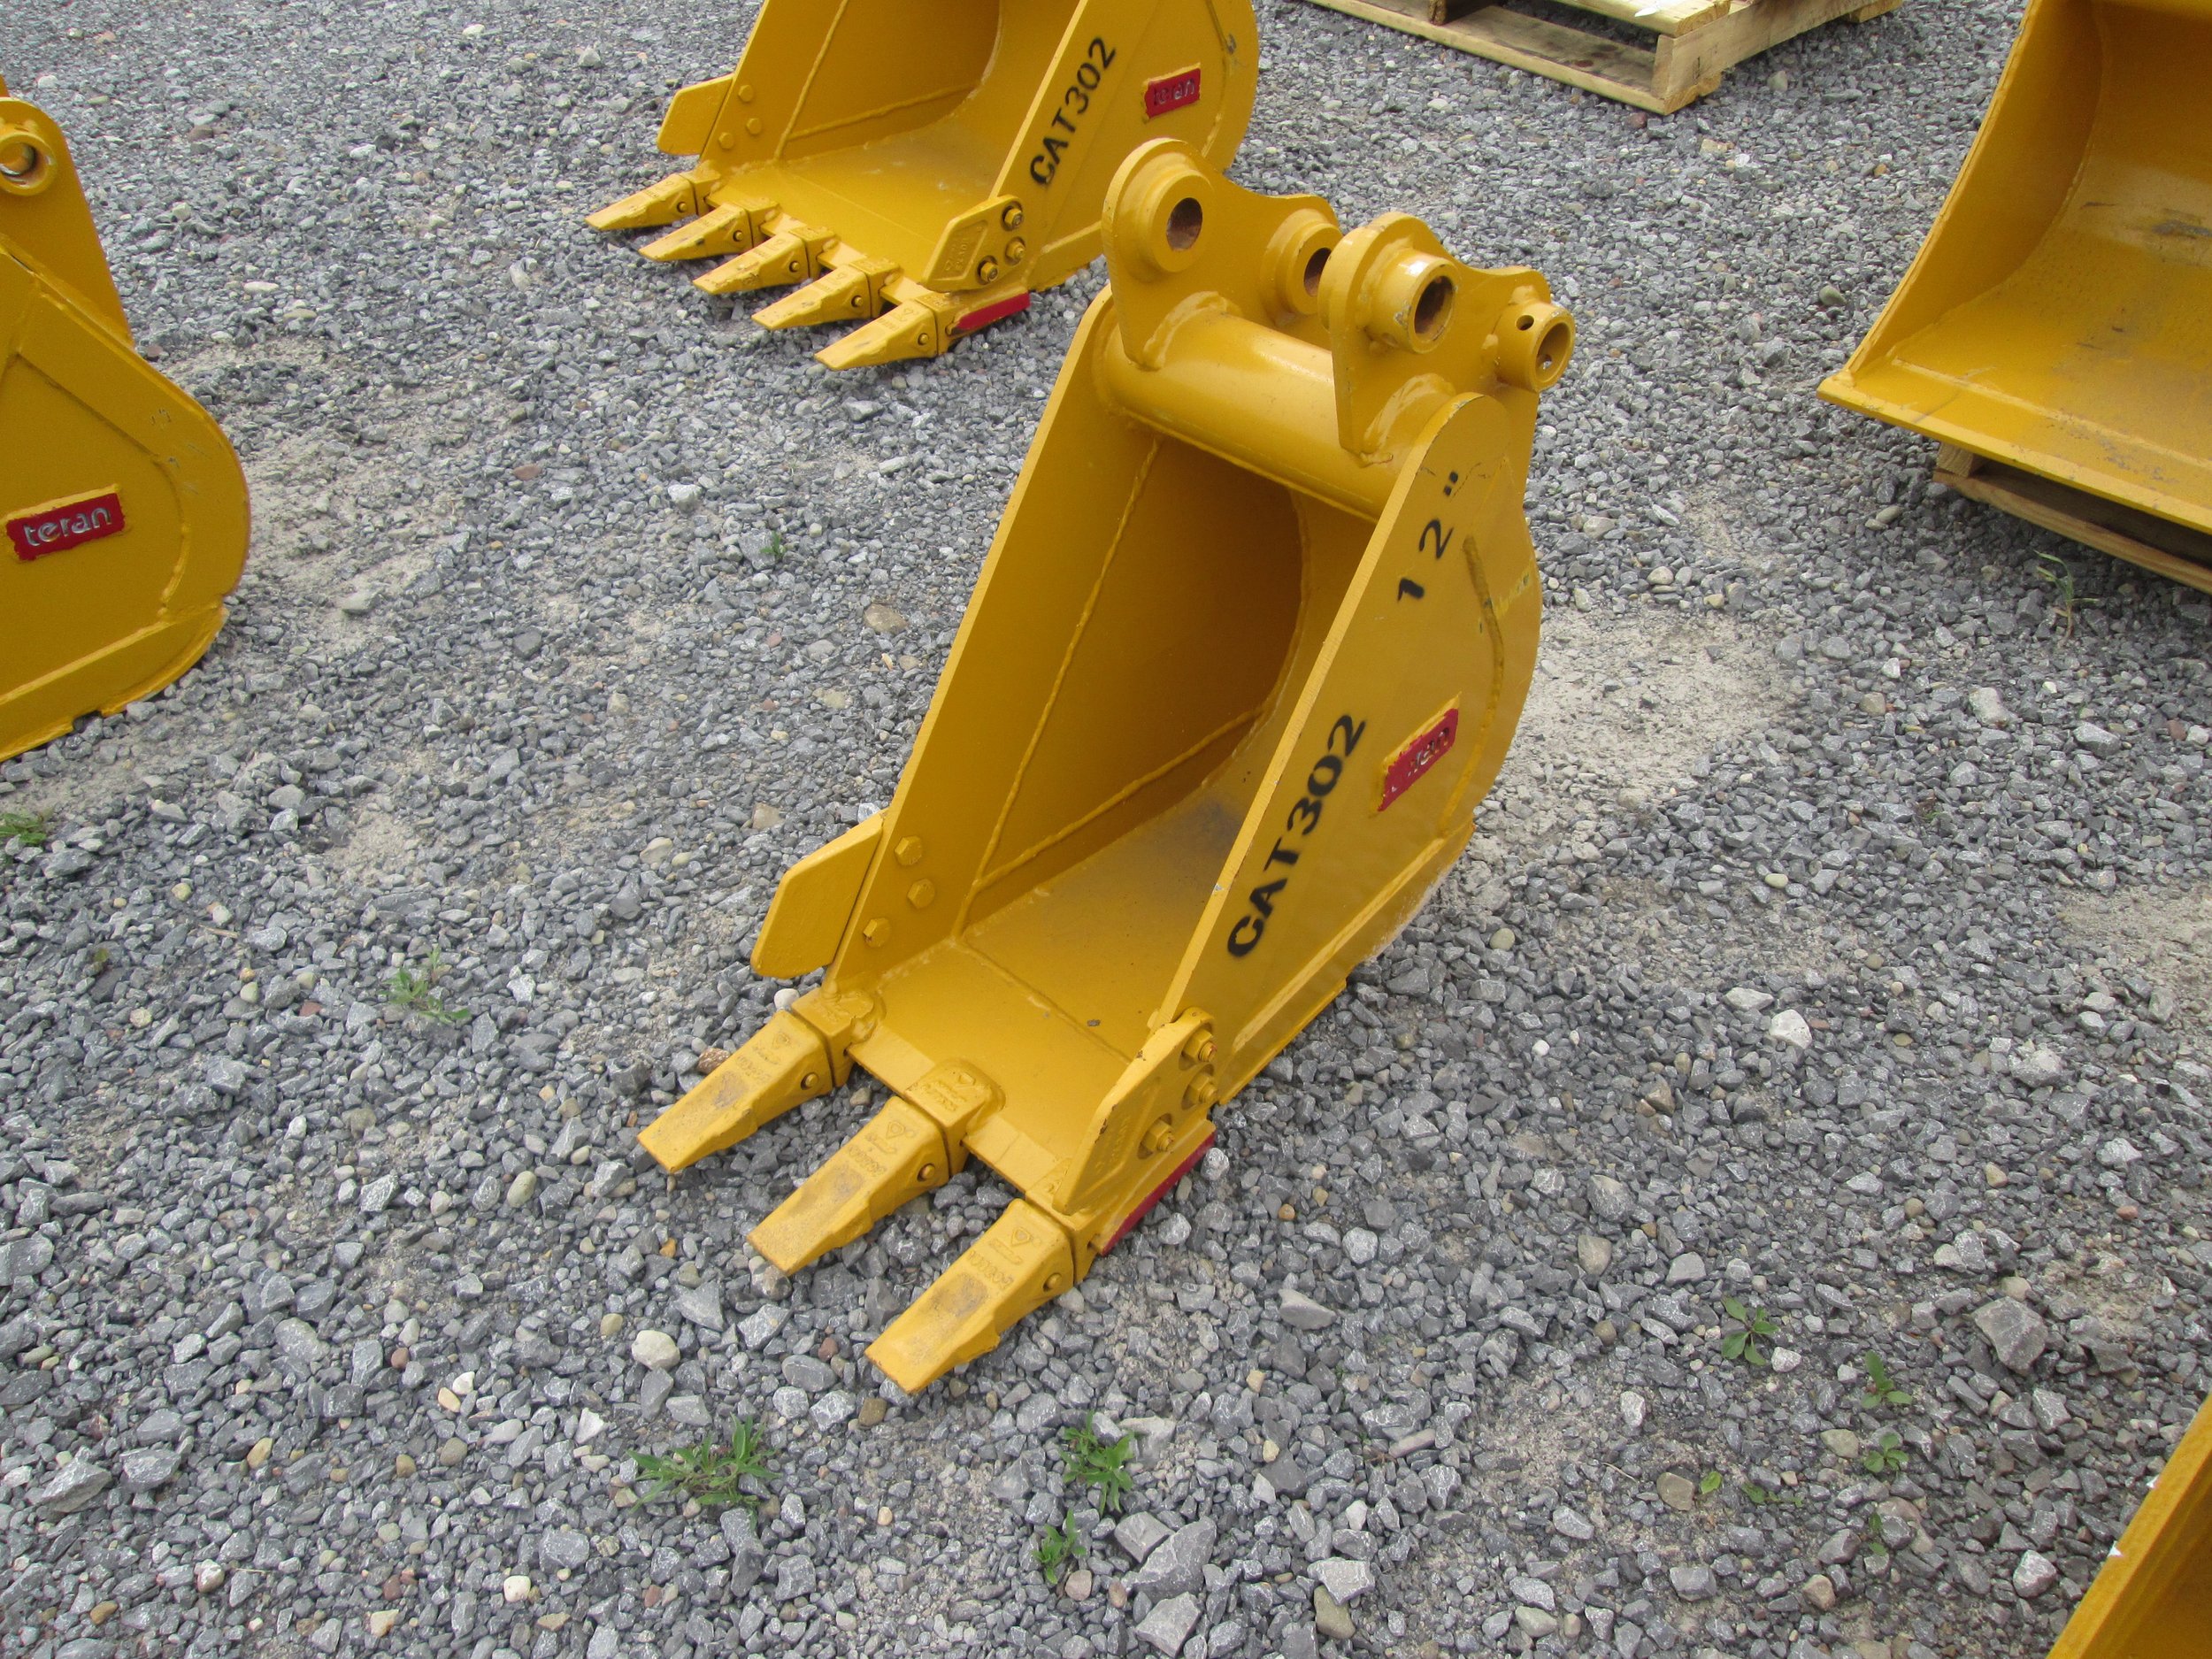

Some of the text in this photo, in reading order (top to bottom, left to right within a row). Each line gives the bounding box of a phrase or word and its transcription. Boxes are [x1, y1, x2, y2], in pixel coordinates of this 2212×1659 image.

[1030, 37, 1116, 188] CAT302
[23, 507, 111, 546] teran
[1227, 715, 1366, 958] CAT302
